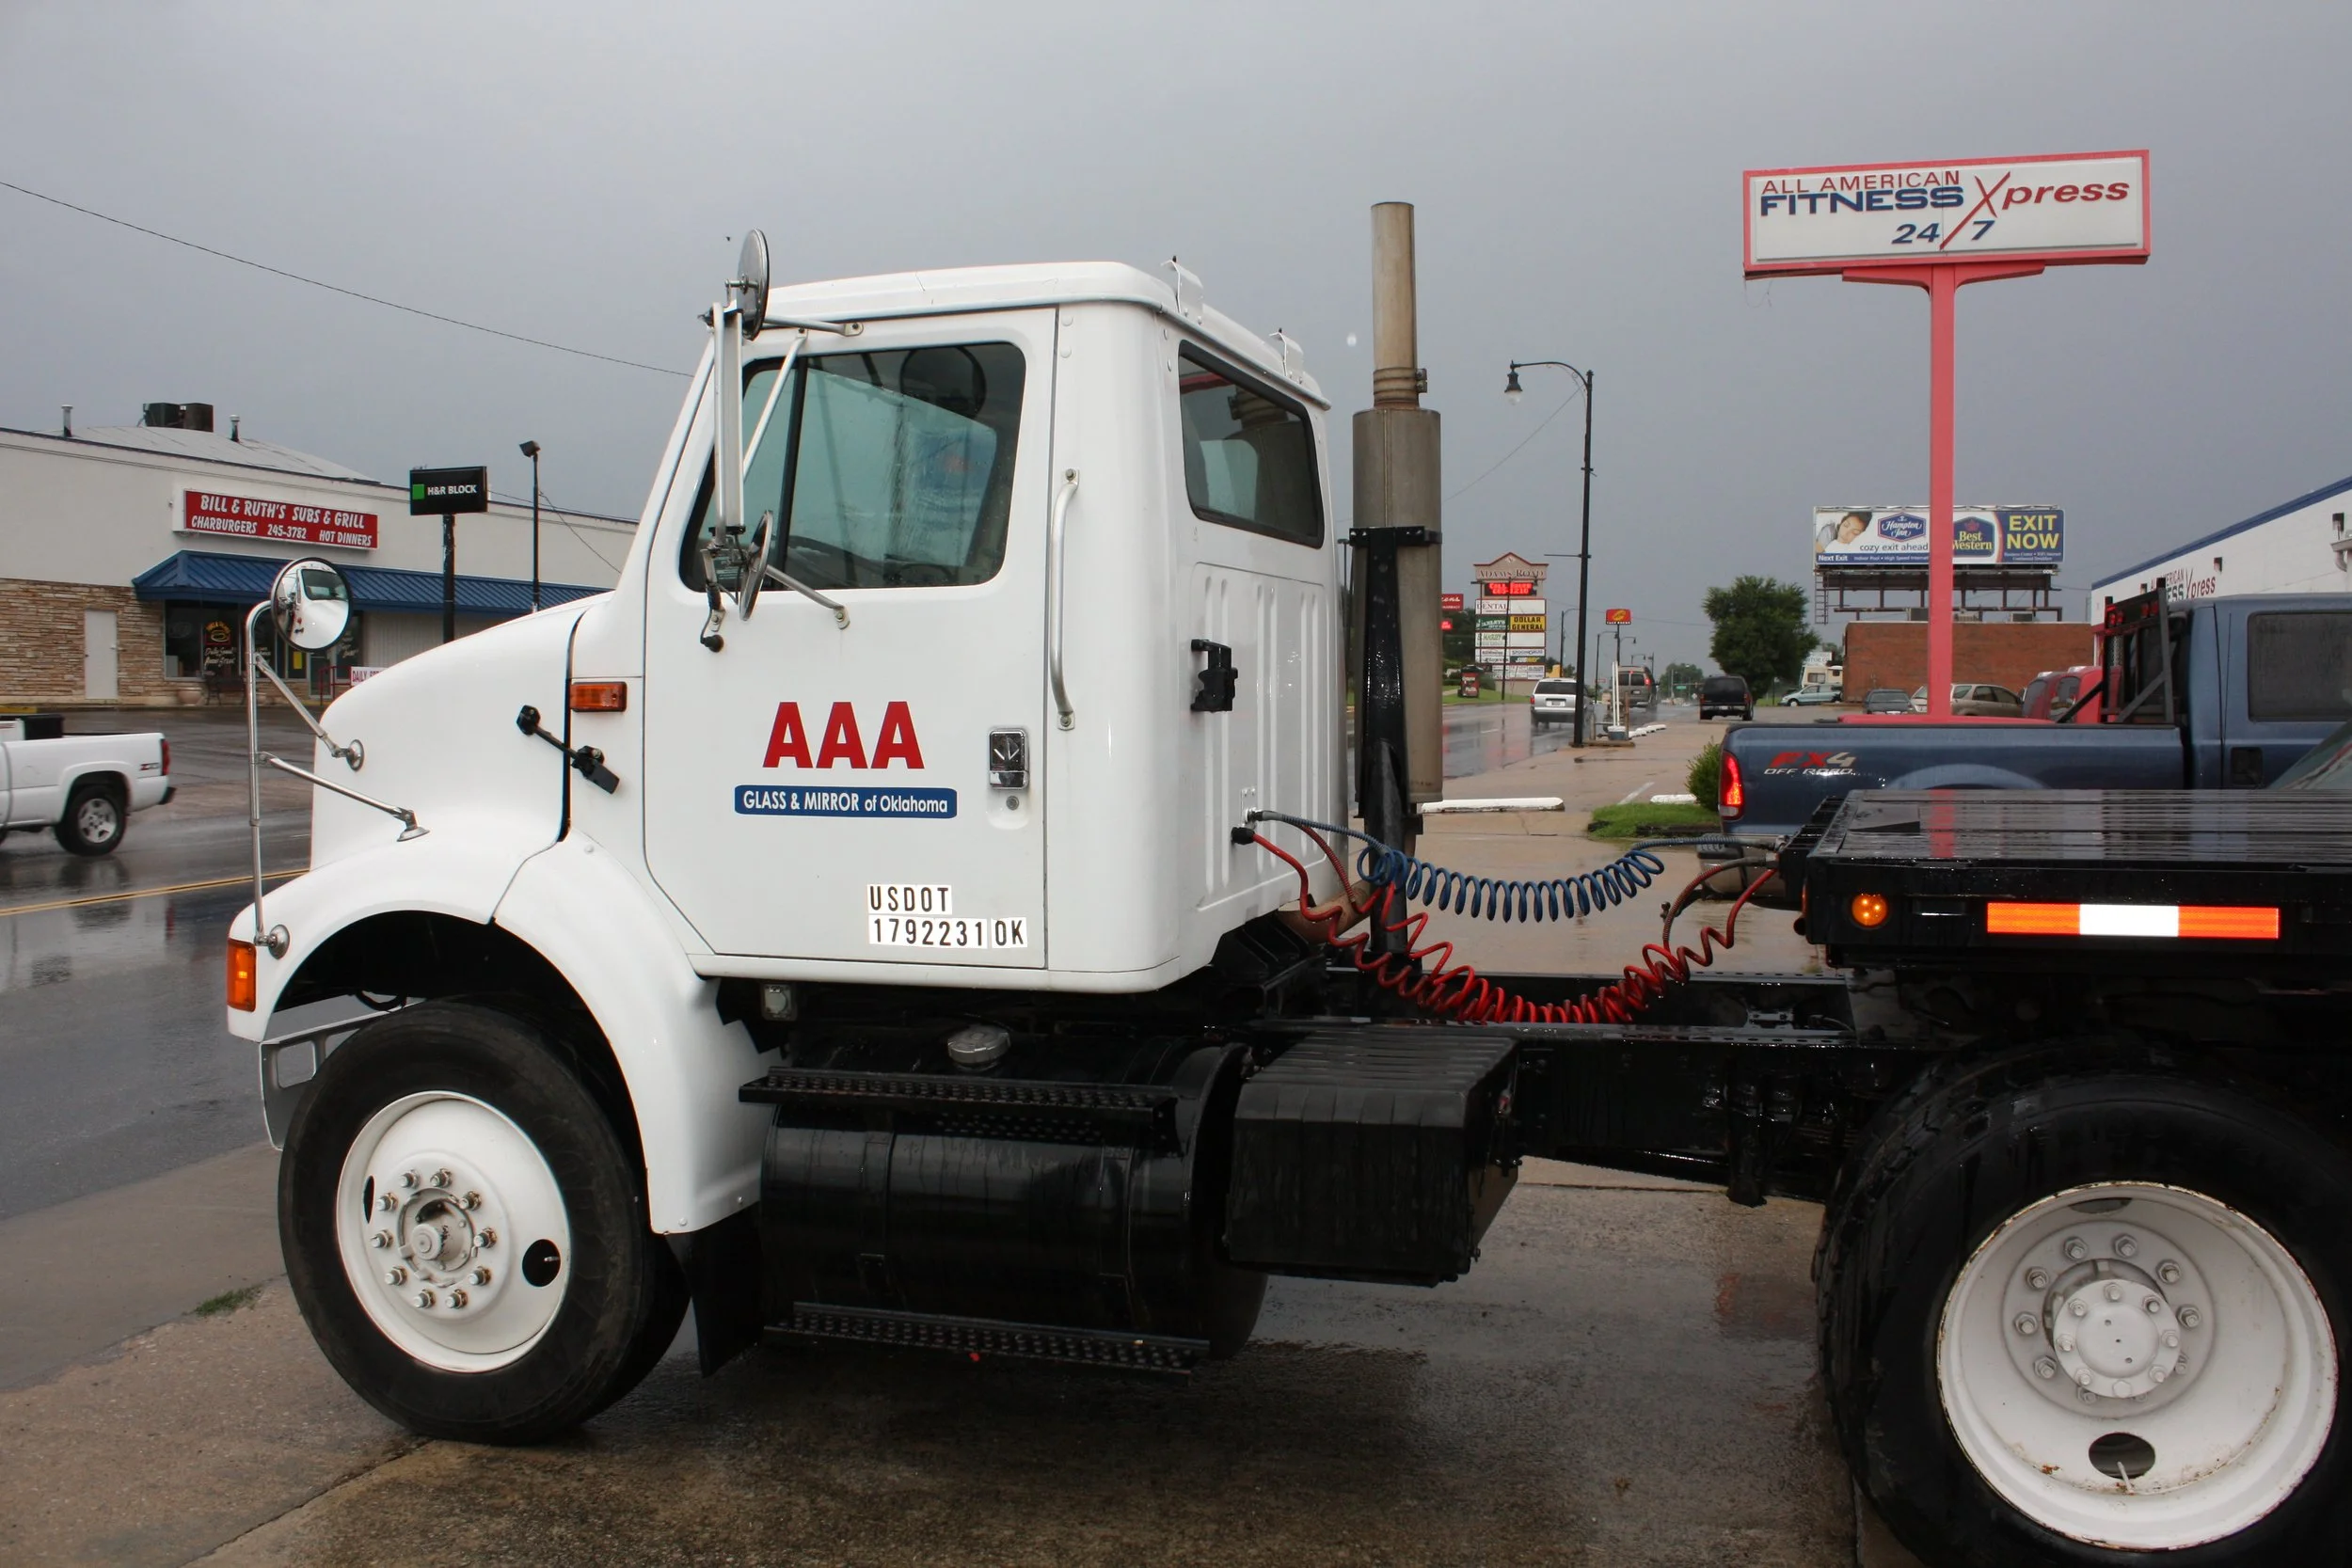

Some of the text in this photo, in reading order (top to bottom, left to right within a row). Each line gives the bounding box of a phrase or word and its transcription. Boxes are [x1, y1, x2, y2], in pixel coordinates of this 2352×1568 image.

[1760, 169, 1961, 195] ALL AMERICAN
[1760, 185, 1964, 216] FITNESS
[1890, 219, 1996, 250] 24/7
[426, 483, 478, 496] H&R BLOCK
[199, 494, 365, 529] BILL & RUTH'S SUBS & GRILL
[191, 515, 373, 546] CHARBURGERS 245-3782 HOT DINNERS
[1882, 520, 1922, 531] Hampton
[2009, 515, 2058, 531] EXIT
[1891, 529, 1912, 538] Inn
[1959, 531, 1983, 542] Best
[2007, 532, 2059, 549] NOW
[1859, 545, 1879, 553] cozy
[1900, 543, 1929, 551] ahead
[1480, 568, 1544, 578] ADAMS ROAD
[762, 701, 926, 769] AAA
[1770, 752, 1857, 768] FX4
[742, 790, 948, 813] GLASS & MIRROR of Oklahoma
[869, 885, 949, 912] USDOT
